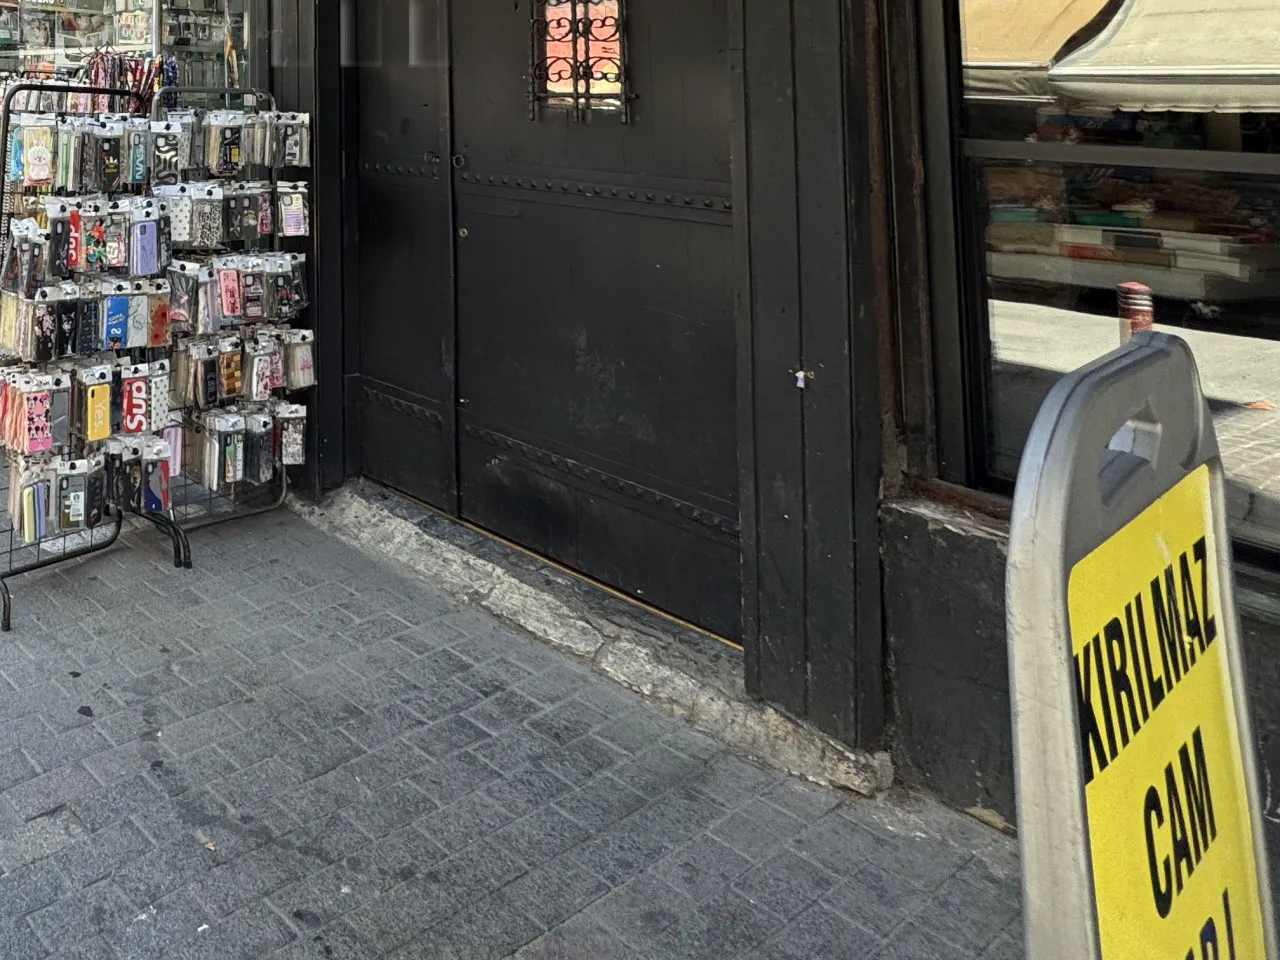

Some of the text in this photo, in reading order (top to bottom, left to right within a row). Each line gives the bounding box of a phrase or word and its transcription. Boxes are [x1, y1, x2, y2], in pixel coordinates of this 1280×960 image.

[92, 401, 107, 430] Yes.
[126, 380, 148, 432] Sup
[1073, 536, 1218, 787] KIRILMAZ
[1144, 724, 1217, 919] CAM
